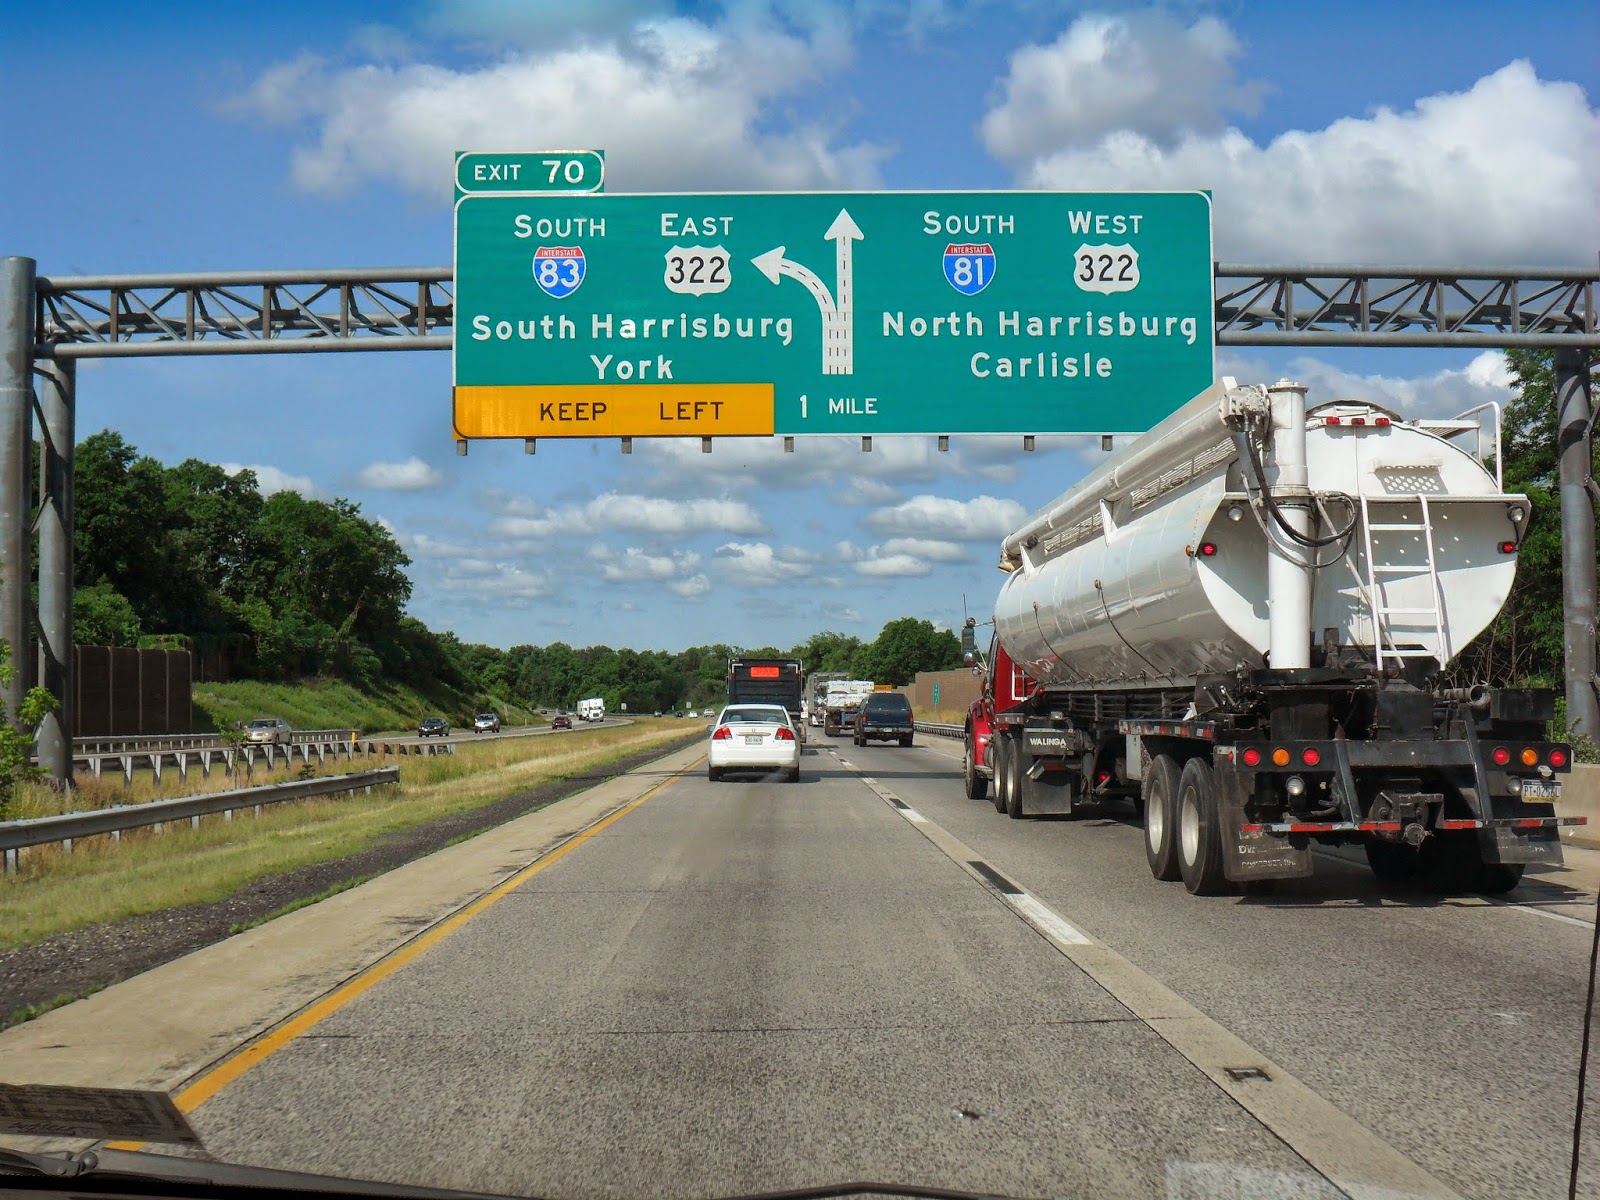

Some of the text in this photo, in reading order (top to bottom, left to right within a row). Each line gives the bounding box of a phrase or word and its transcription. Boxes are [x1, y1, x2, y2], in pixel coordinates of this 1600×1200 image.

[474, 159, 585, 184] EXIT 70
[514, 214, 606, 239] SOUTH
[661, 213, 734, 237] EAST
[923, 210, 1015, 235] SOUTH
[1068, 210, 1143, 235] WEST
[541, 249, 578, 257] INTERSTATE
[950, 246, 987, 254] INTERSTATE
[539, 258, 580, 288] 83
[669, 255, 726, 284] 322
[953, 256, 983, 286] 81
[1079, 254, 1134, 282] 322
[471, 313, 793, 346] South Harrisburg
[883, 311, 1198, 346] North Harrisburg
[590, 354, 674, 380] York
[970, 351, 1113, 378] Carlisle
[540, 401, 724, 422] KEEP LEFT
[799, 394, 878, 418] 1 MILE
[1030, 738, 1067, 746] WALINGA
